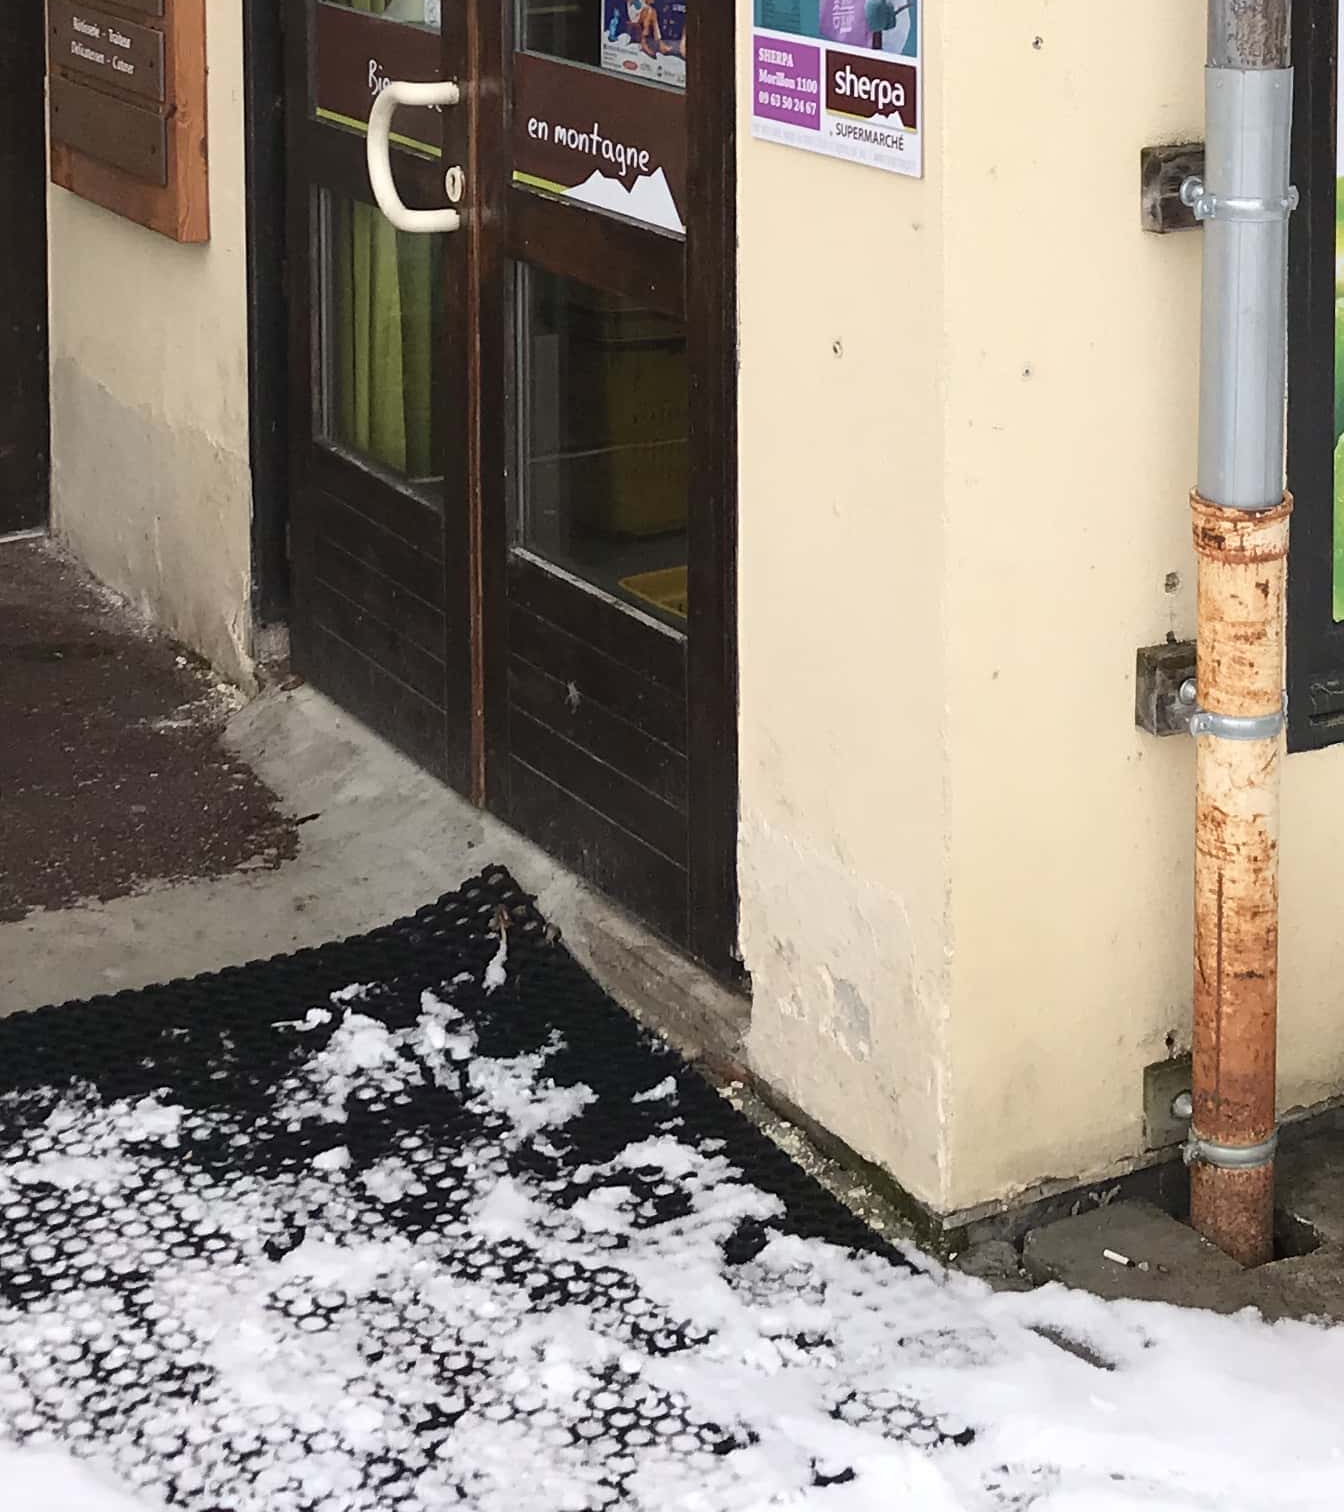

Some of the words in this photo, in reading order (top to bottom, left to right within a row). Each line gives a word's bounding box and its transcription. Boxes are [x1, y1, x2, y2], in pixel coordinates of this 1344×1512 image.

[758, 46, 795, 68] SHERPA
[834, 64, 905, 109] sherpa
[527, 117, 548, 142] en
[554, 122, 650, 178] montagne
[835, 121, 905, 152] SUPERMARCHÉ
